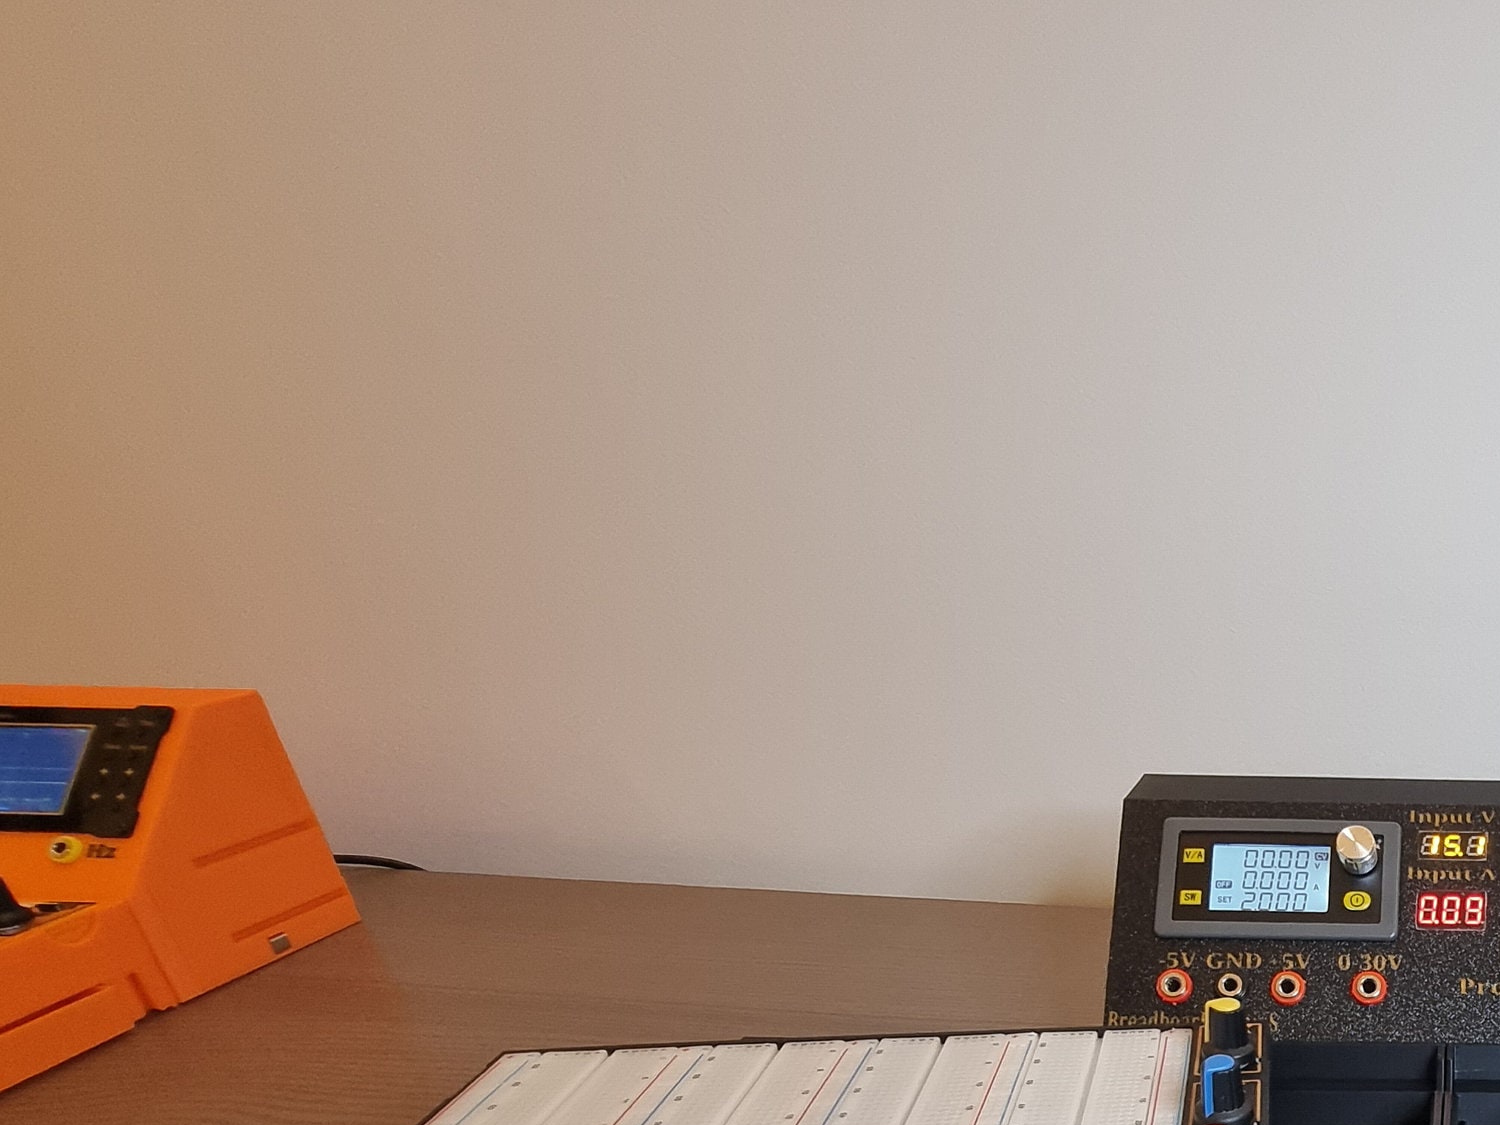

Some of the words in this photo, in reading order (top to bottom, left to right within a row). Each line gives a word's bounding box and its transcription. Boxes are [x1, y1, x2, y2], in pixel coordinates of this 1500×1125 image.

[1409, 809, 1472, 827] Input
[1482, 810, 1496, 824] V
[1184, 848, 1203, 860] V/A
[1243, 849, 1310, 869] 00.00
[1216, 881, 1232, 889] OFF
[1241, 870, 1310, 891] 0.000
[1183, 893, 1196, 902] SW
[1217, 895, 1233, 904] SET
[1206, 952, 1263, 970] GND
